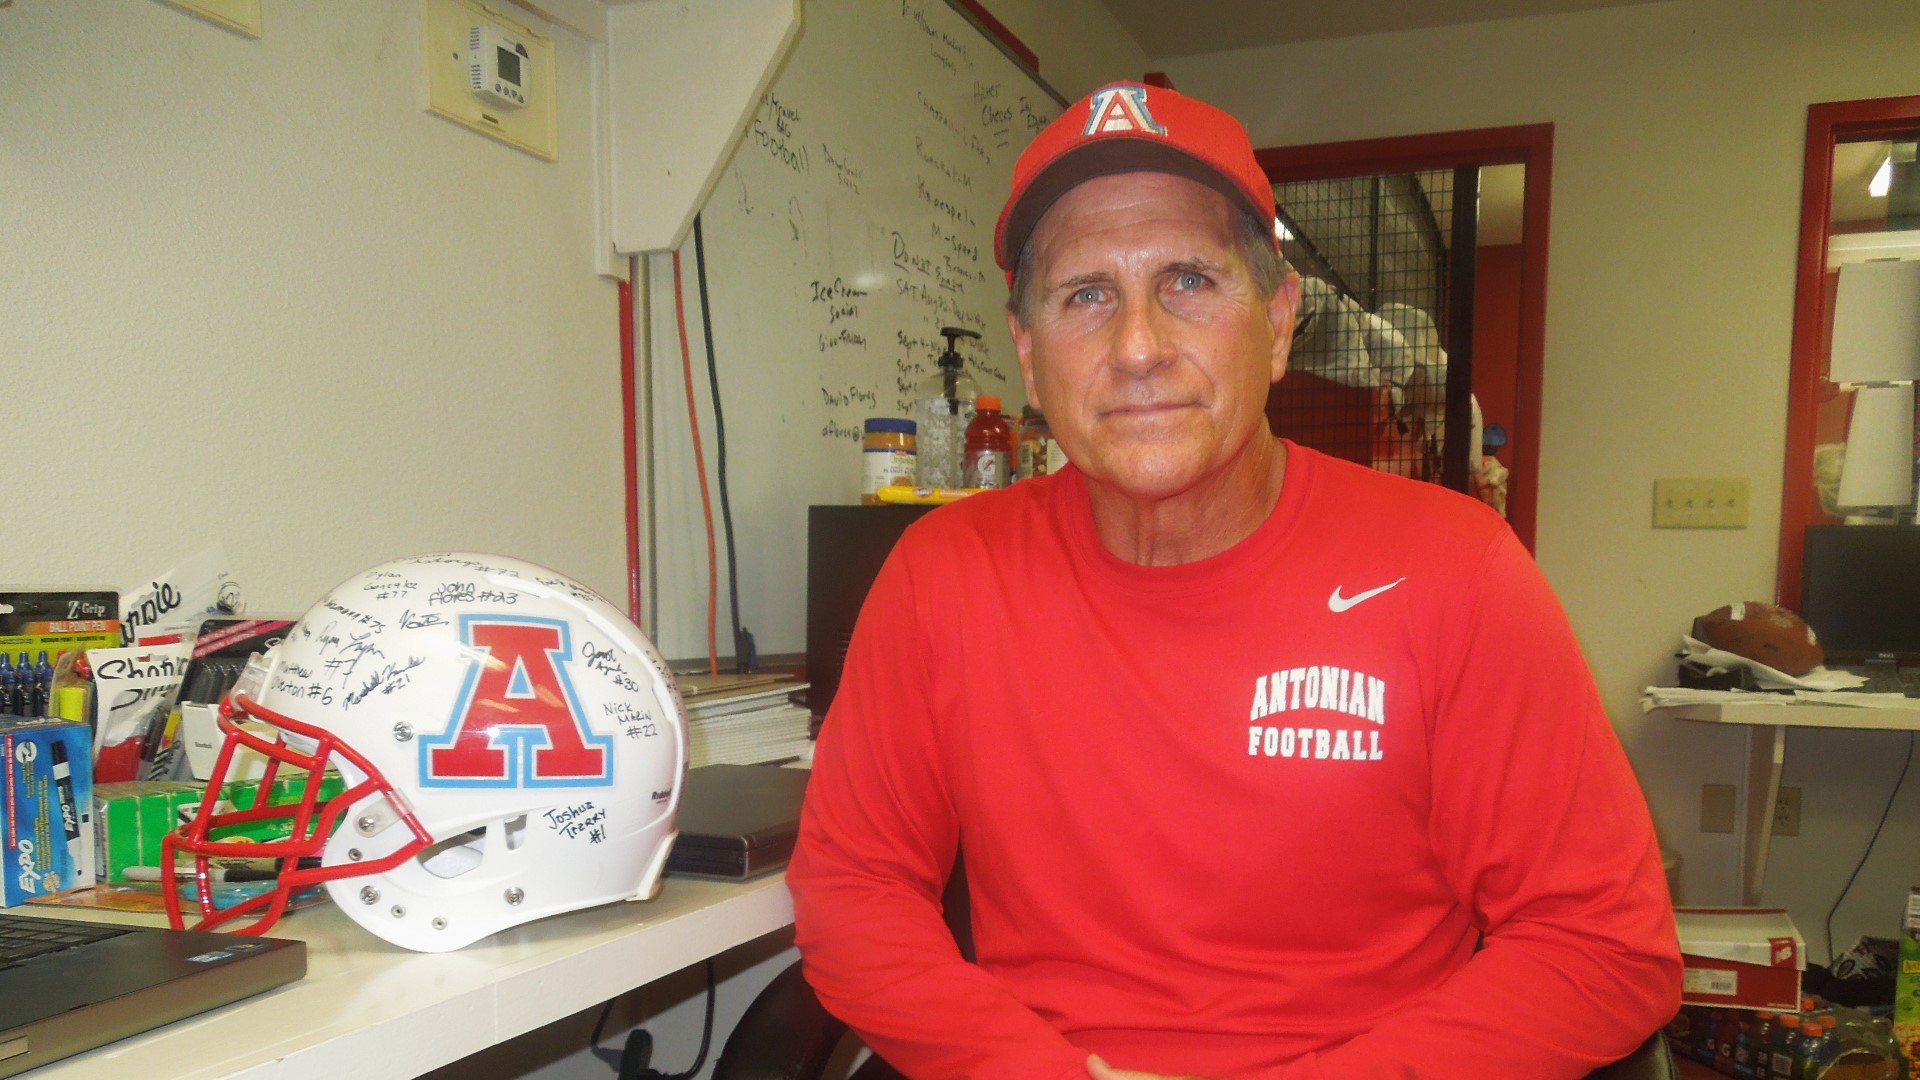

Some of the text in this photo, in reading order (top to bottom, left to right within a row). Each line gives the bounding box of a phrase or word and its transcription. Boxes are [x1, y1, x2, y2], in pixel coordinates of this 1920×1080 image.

[1081, 86, 1168, 136] A
[418, 613, 614, 788] A
[1250, 666, 1386, 725] ANTONIAN
[626, 723, 659, 740] #22
[1248, 726, 1384, 761] FOOTBALL
[17, 839, 42, 893] EXPO
